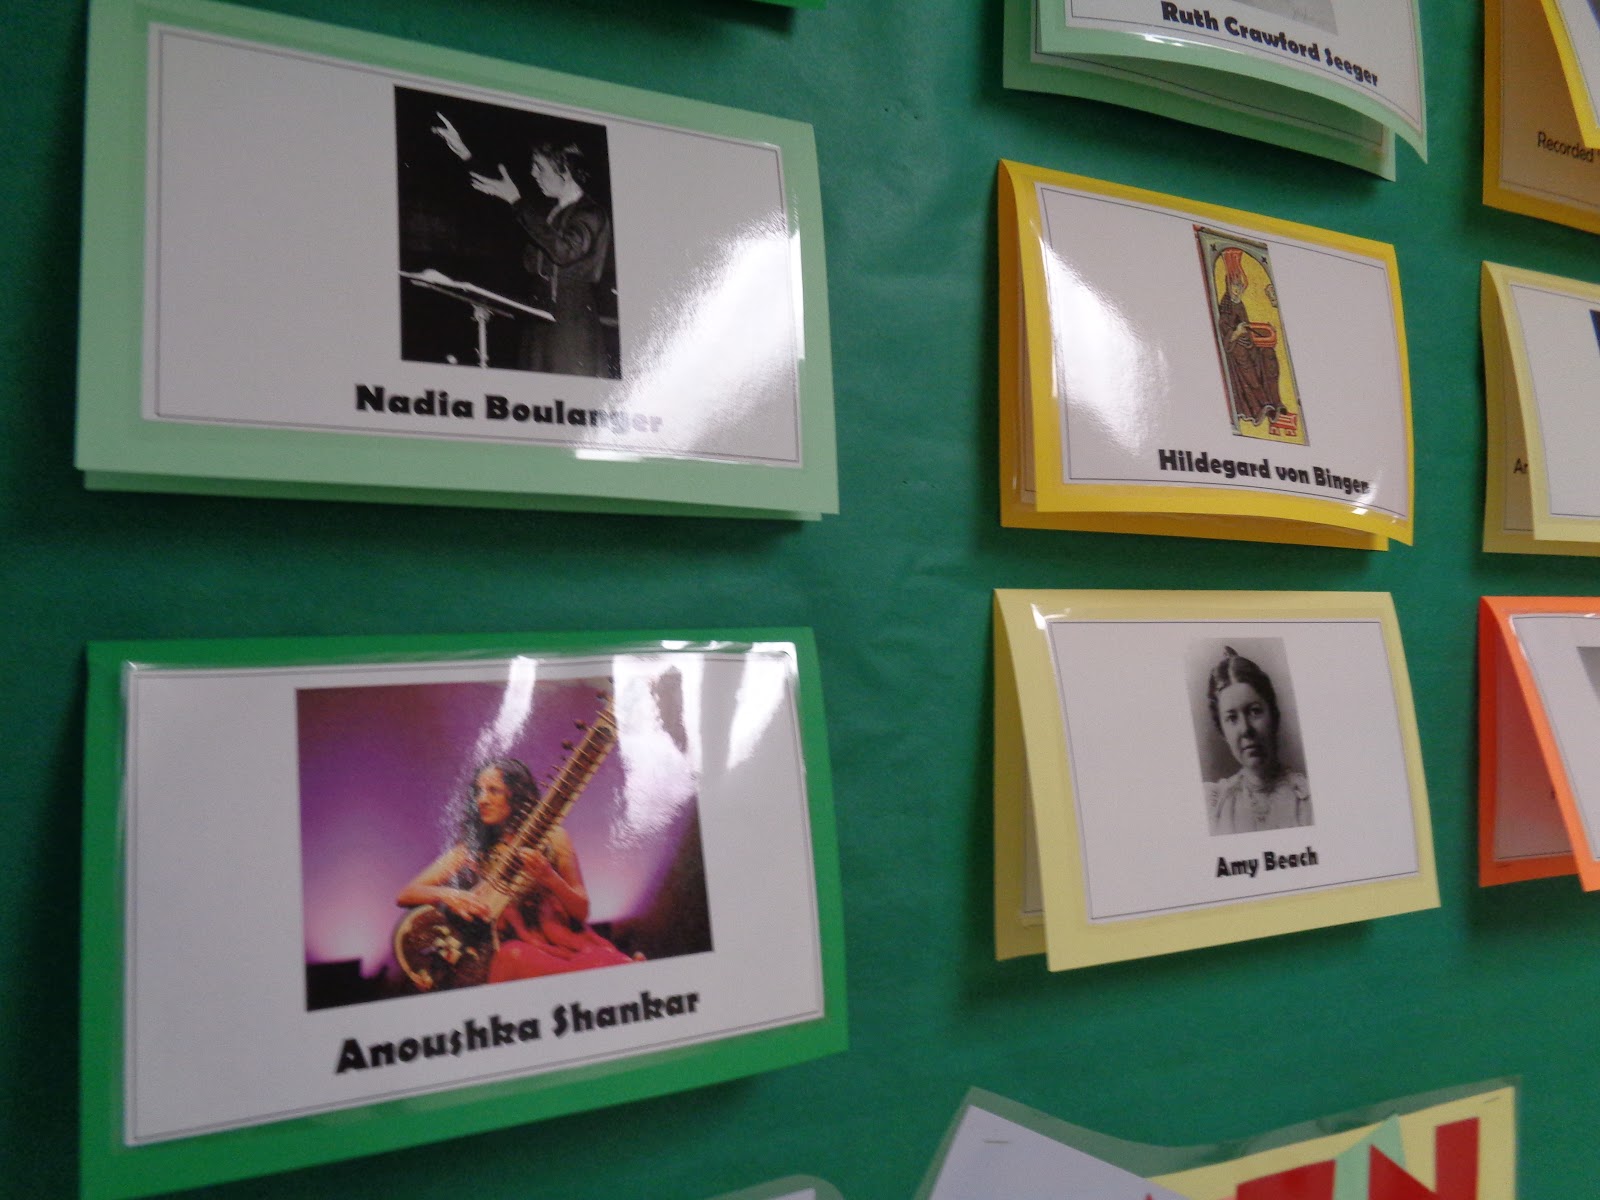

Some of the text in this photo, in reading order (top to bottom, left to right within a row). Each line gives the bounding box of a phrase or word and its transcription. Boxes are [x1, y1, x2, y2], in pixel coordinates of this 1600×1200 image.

[1161, 1, 1378, 87] Ruth Crawford Seeger
[1537, 131, 1594, 163] Recorded
[356, 385, 663, 434] Nadia Boulanger
[1158, 449, 1271, 479] Hildegard
[1275, 466, 1310, 484] von
[1217, 846, 1319, 877] Amy Beach
[335, 991, 699, 1074] Anoushka Shankar
